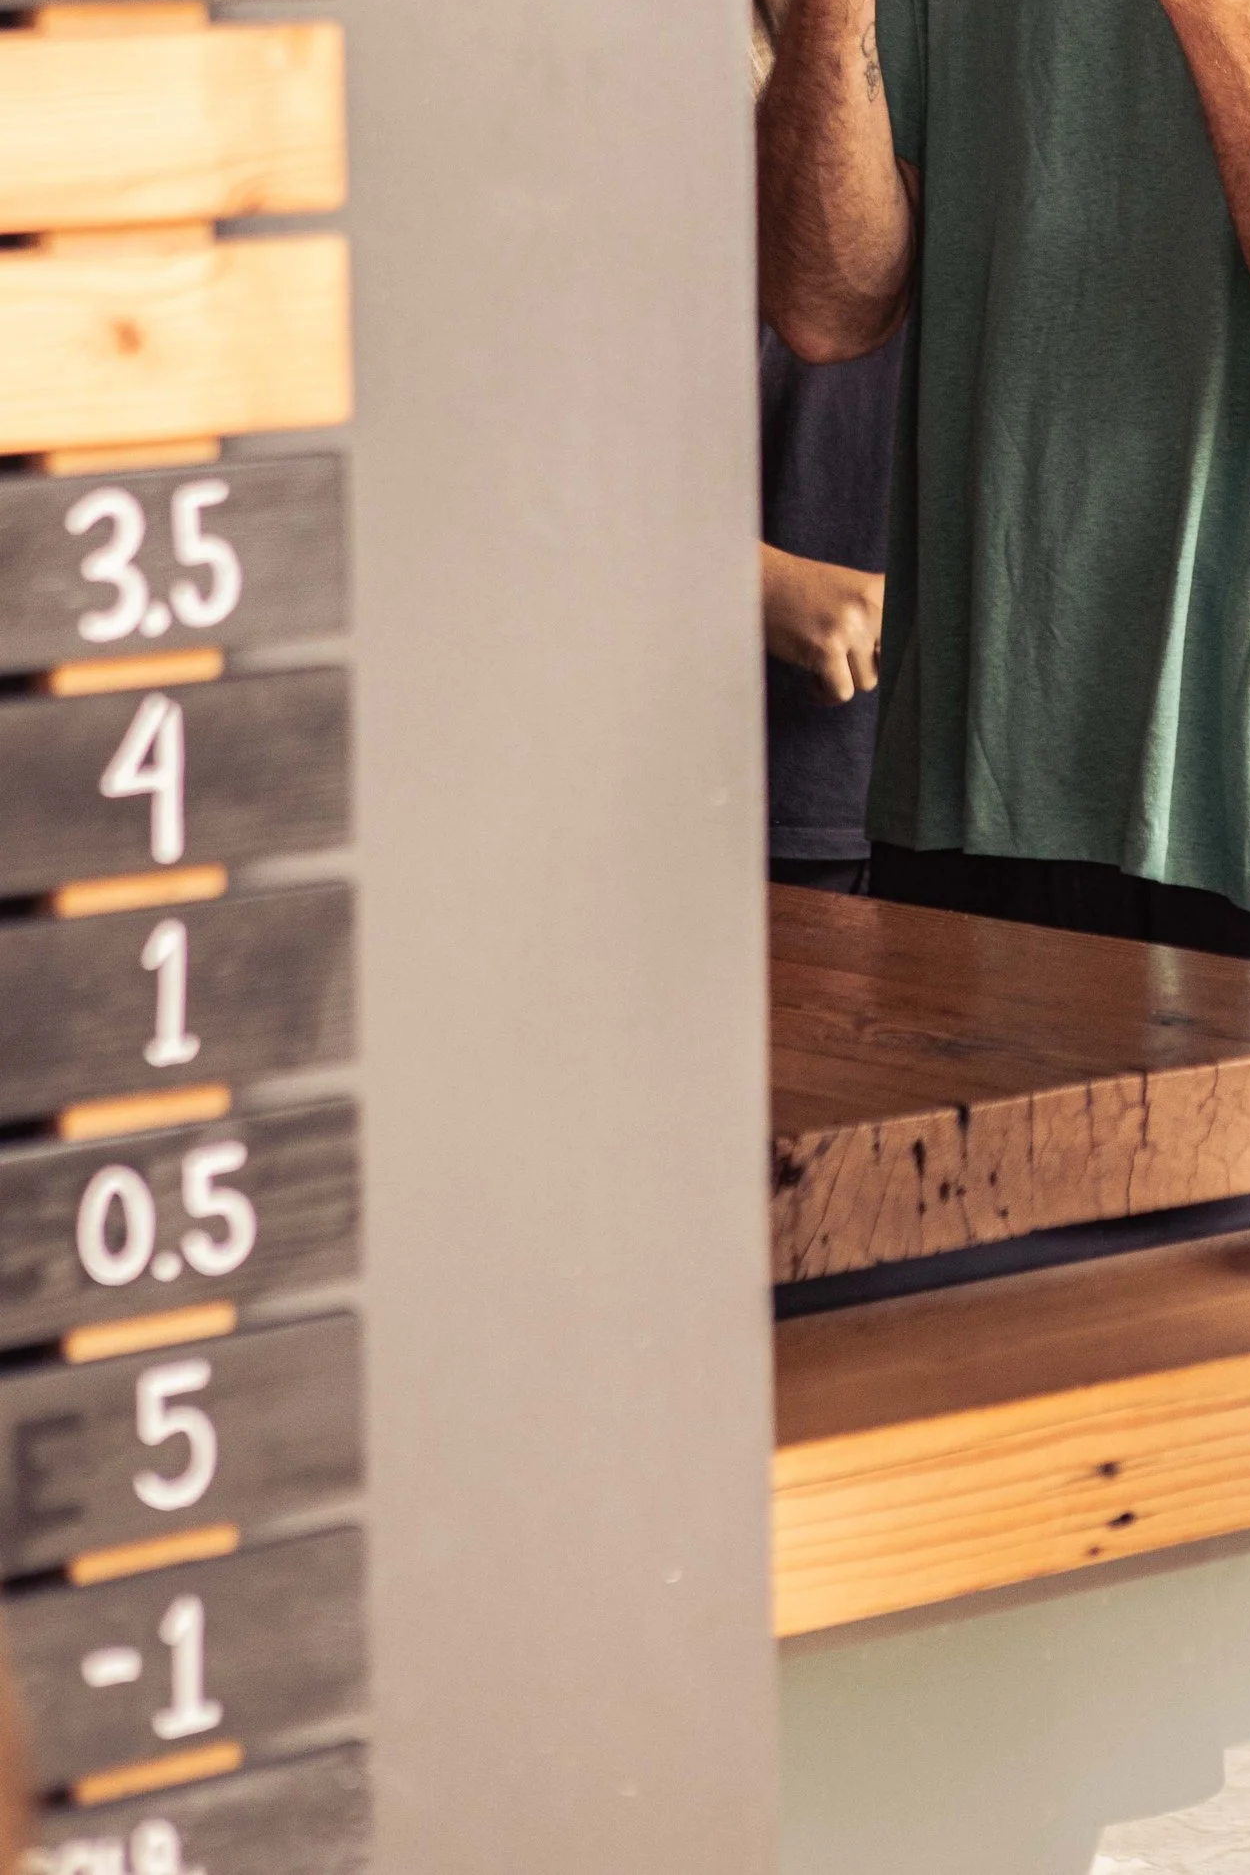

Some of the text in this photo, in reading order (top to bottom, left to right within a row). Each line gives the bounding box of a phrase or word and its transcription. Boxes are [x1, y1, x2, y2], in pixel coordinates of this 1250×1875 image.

[65, 479, 243, 643] 3.5
[101, 693, 185, 865] 4
[140, 918, 201, 1068] 1
[77, 1141, 257, 1287] 0.5
[133, 1359, 218, 1512] 5
[81, 1596, 222, 1740] -1
